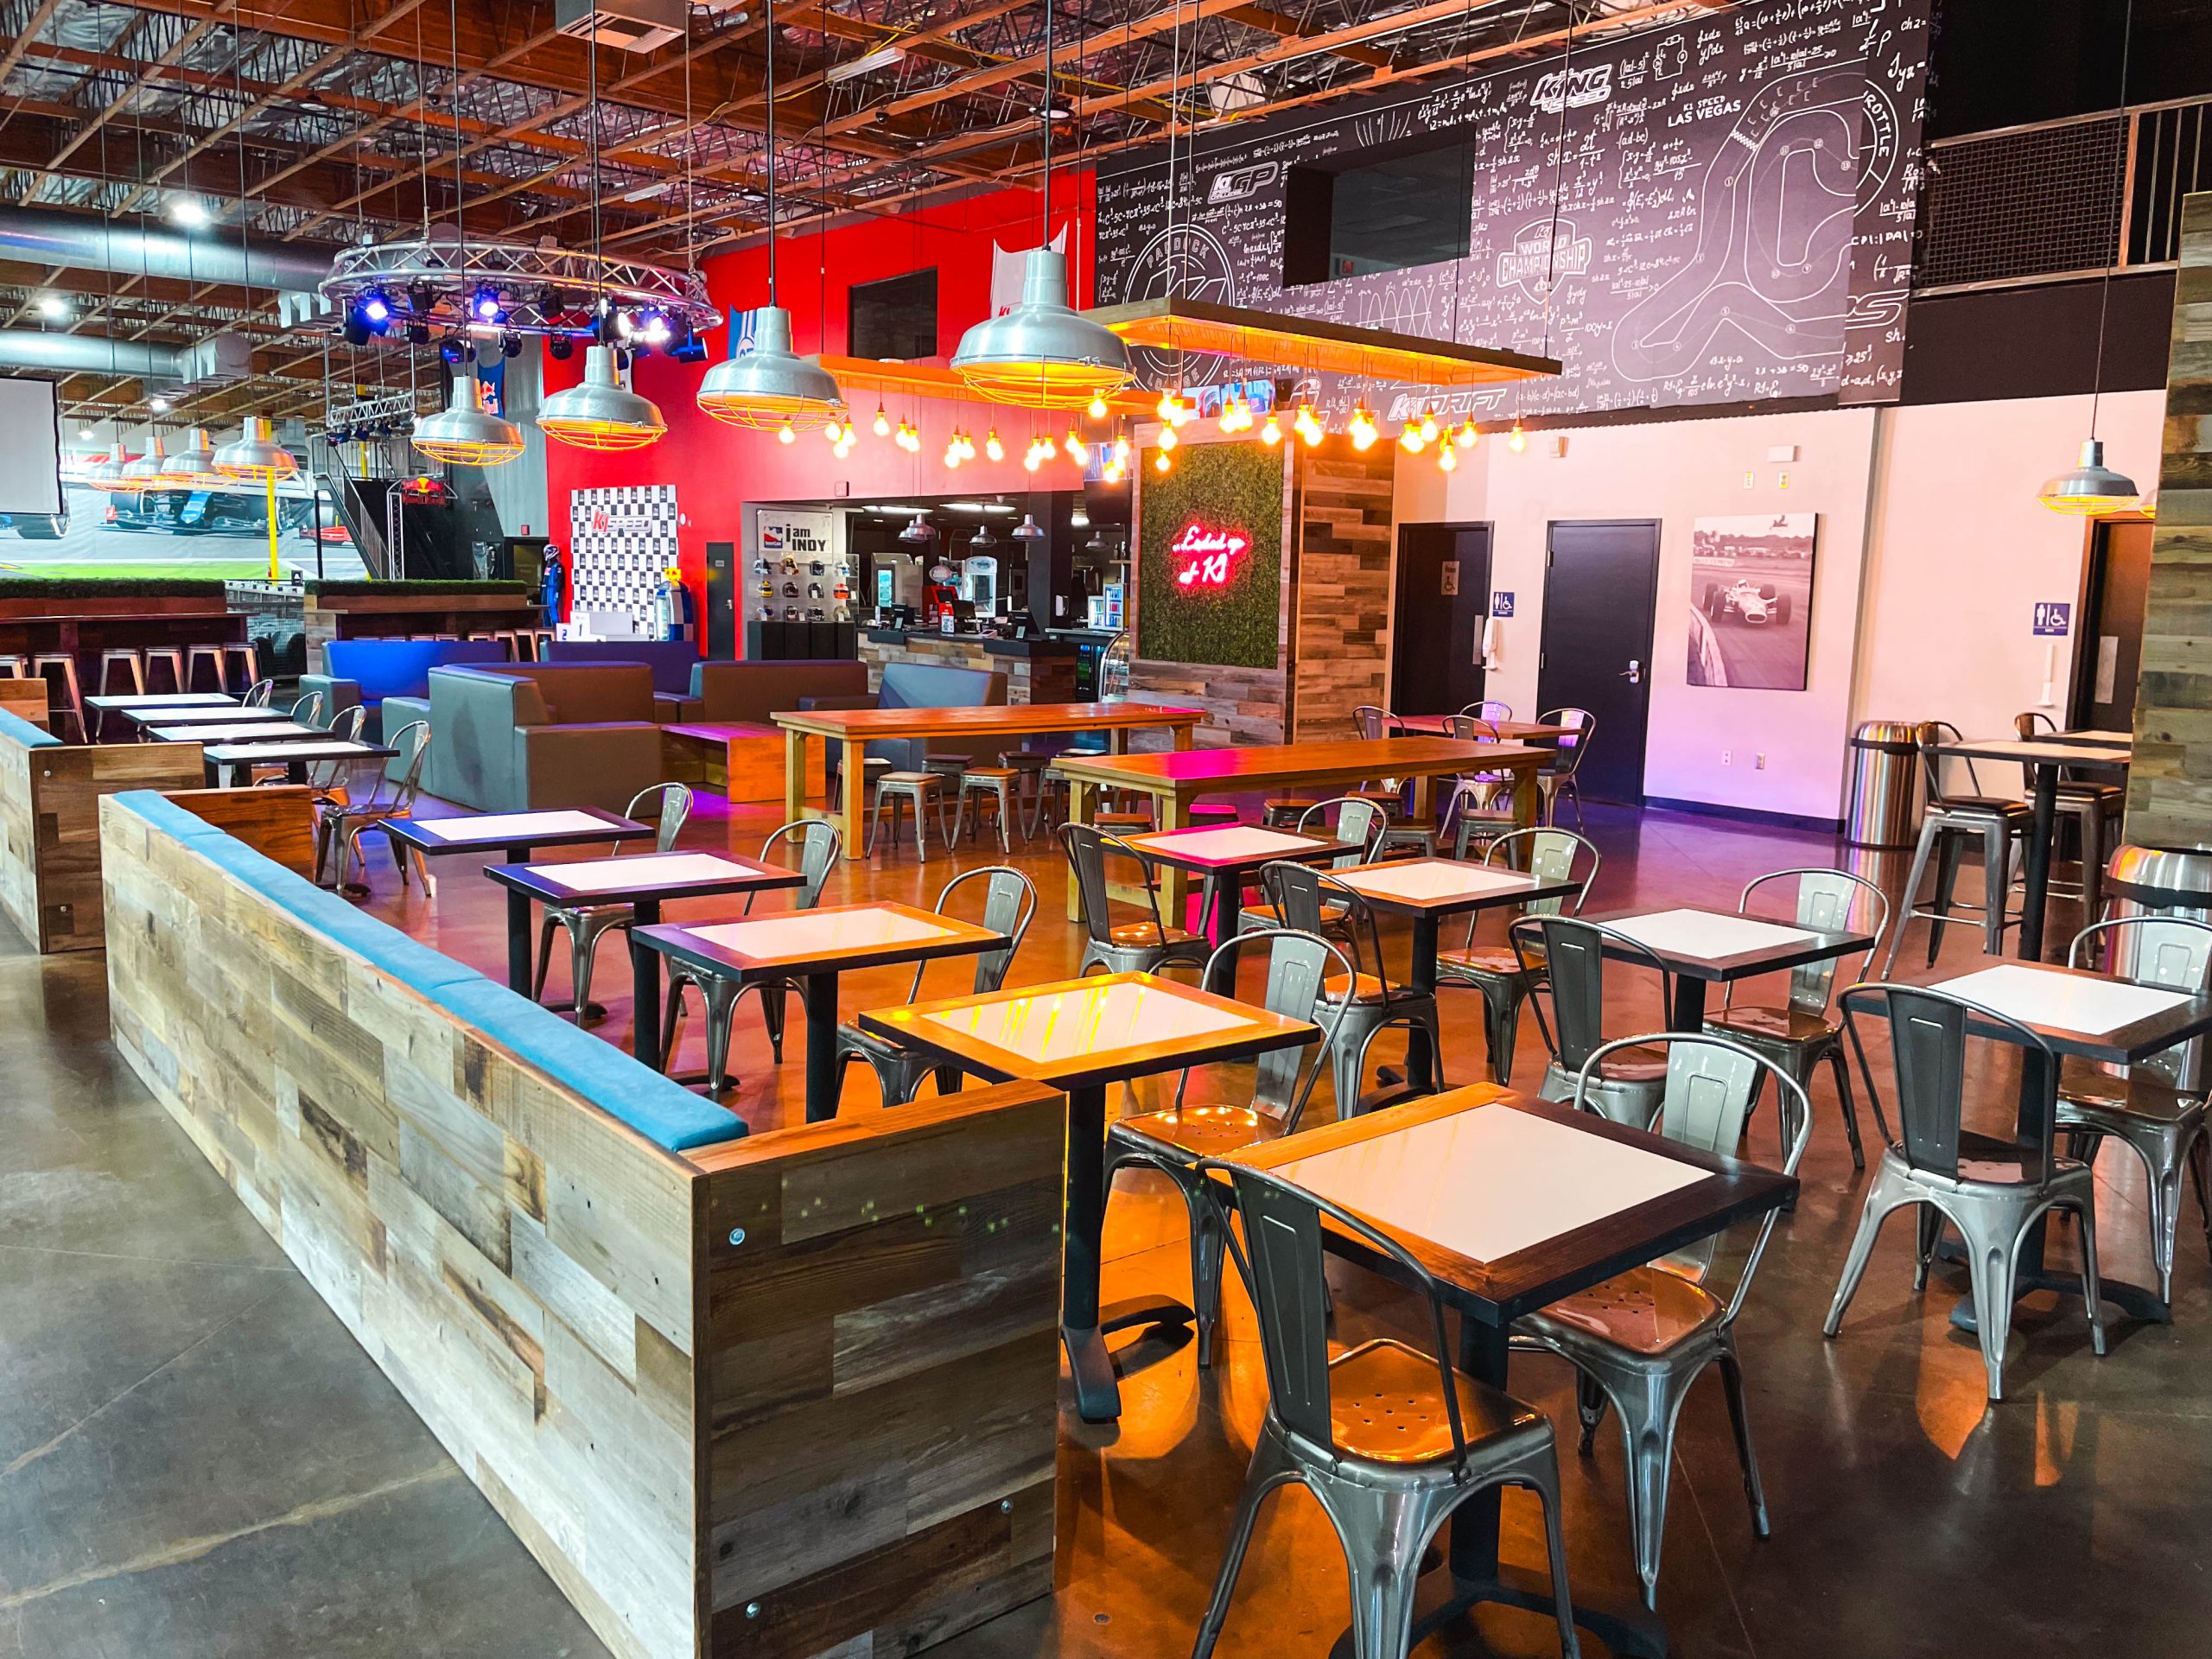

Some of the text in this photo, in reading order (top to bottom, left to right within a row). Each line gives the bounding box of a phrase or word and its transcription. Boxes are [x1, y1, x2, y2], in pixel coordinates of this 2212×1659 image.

[1668, 111, 1693, 128] LAS
[1695, 99, 1741, 121] VEGAS
[1683, 95, 1726, 111] K1 SPEED
[1864, 90, 1892, 158] ROTTLE
[1230, 165, 1275, 194] GP
[1147, 237, 1210, 269] PADDOCK
[1502, 243, 1586, 283] CHAMPIONSHIP
[1147, 366, 1201, 391] LONGE
[594, 511, 610, 533] K1
[792, 528, 810, 538] am
[791, 538, 827, 552] INDY
